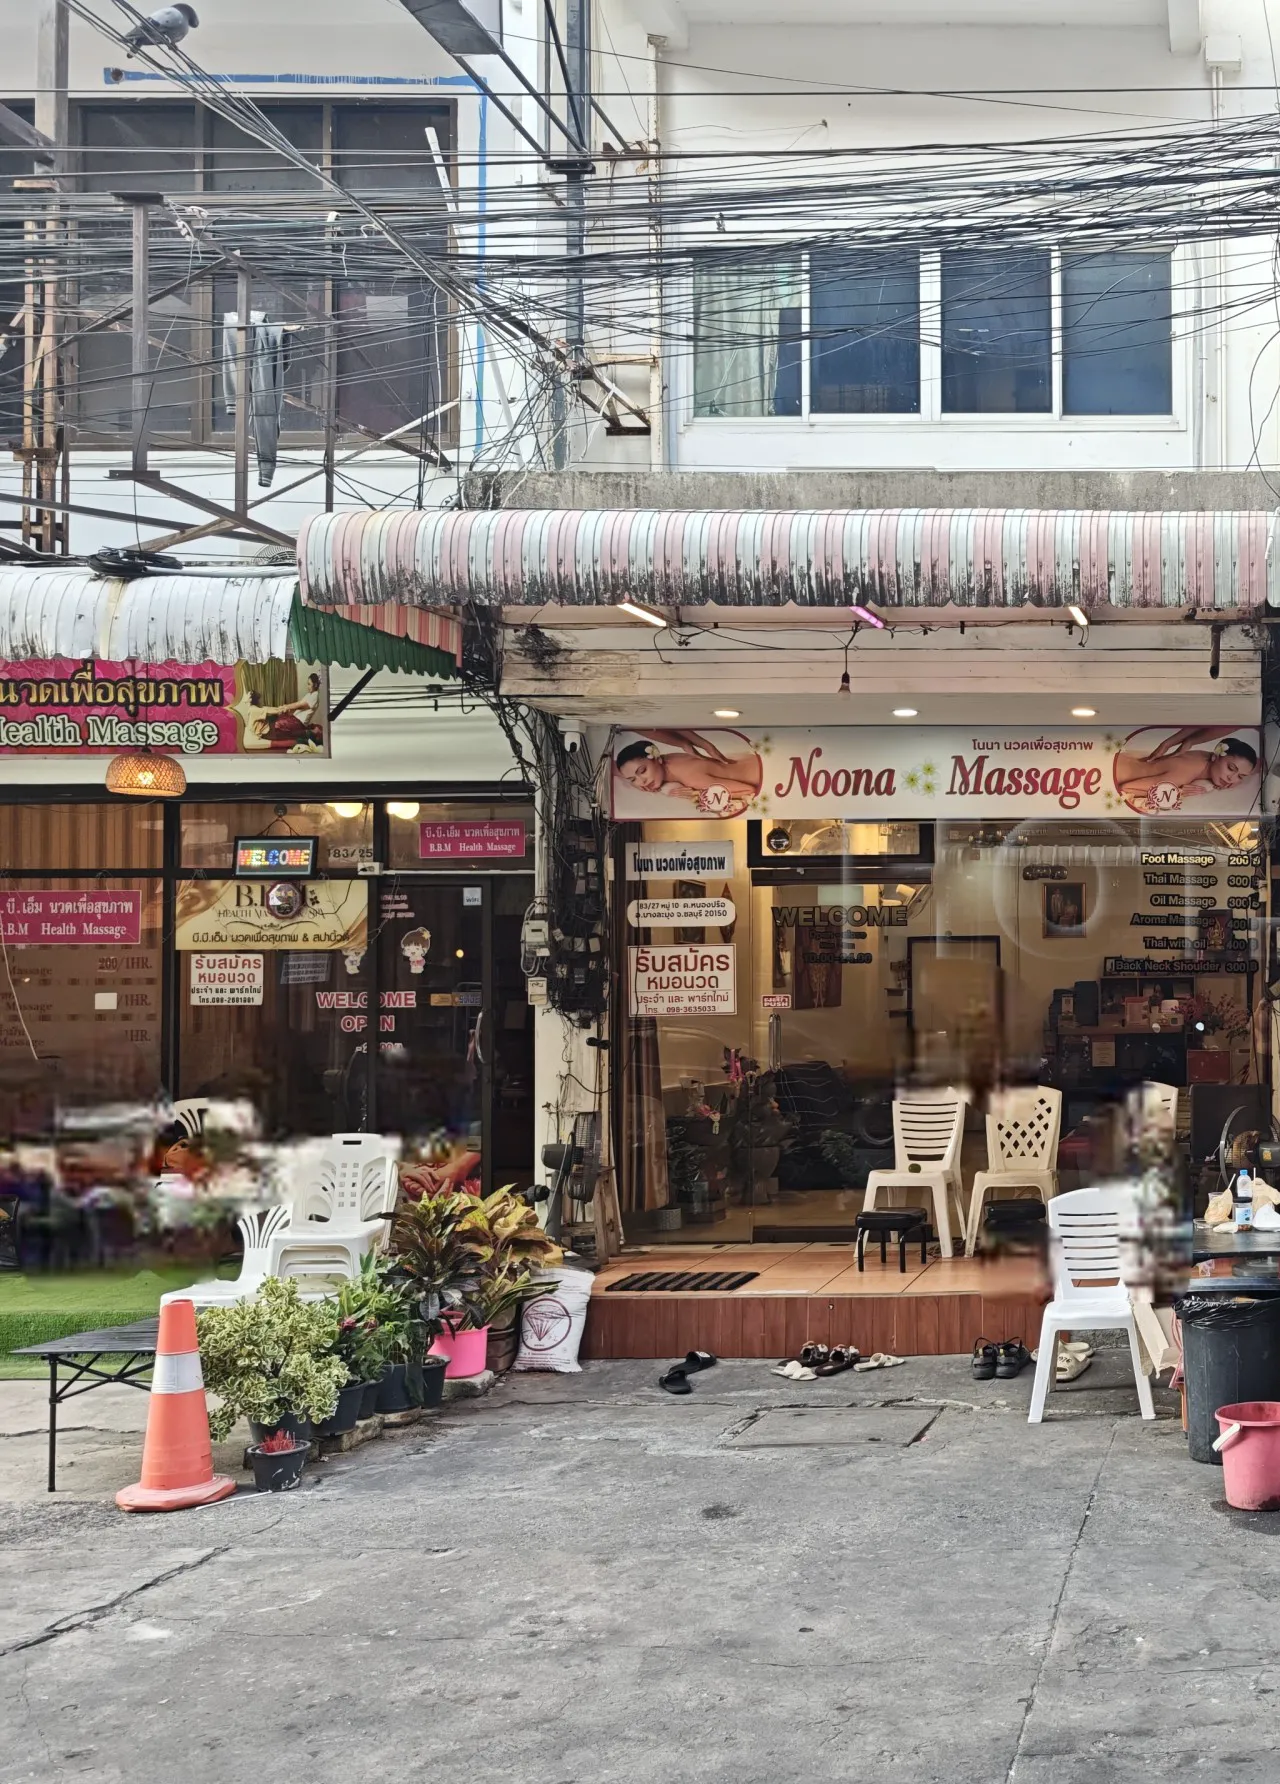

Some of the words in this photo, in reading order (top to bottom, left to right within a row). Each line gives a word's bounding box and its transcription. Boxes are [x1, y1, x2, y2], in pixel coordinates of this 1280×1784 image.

[88, 716, 218, 754] Massage
[971, 738, 1000, 751] โนนา
[1003, 736, 1094, 754] นวดเพื่อสุขภาพ
[774, 746, 897, 799] Noona
[945, 754, 1102, 810] Massage
[459, 842, 483, 852] Health
[487, 841, 516, 854] Massage
[238, 849, 310, 866] WELCOME
[1141, 853, 1166, 864] Foot
[1167, 853, 1214, 867] Massage
[1229, 855, 1249, 866] 200
[1145, 873, 1167, 884] Thai
[1169, 873, 1217, 888] Massage
[1228, 876, 1248, 887] 300
[1151, 895, 1166, 905] Oil
[1168, 894, 1216, 908] Massage
[1228, 898, 1247, 908] 300
[704, 909, 728, 917] 20150
[771, 905, 908, 927] WELCOME
[1132, 914, 1166, 925] Aroma
[1169, 915, 1216, 927] Massage
[41, 922, 77, 936] Health
[82, 922, 127, 939] Massage
[1144, 937, 1166, 948] Thai
[1167, 937, 1192, 948] with
[1193, 937, 1207, 949] oil
[195, 954, 261, 969] รับสมัคร
[635, 947, 730, 973] รับสมัคร
[1115, 960, 1142, 971] Back
[1144, 960, 1171, 971] Neck
[1172, 960, 1220, 971] Shoulder
[198, 972, 256, 984] หมอนวด
[647, 975, 719, 990] หมอนวด
[668, 994, 684, 1004] และ
[341, 1015, 395, 1032] OPN
